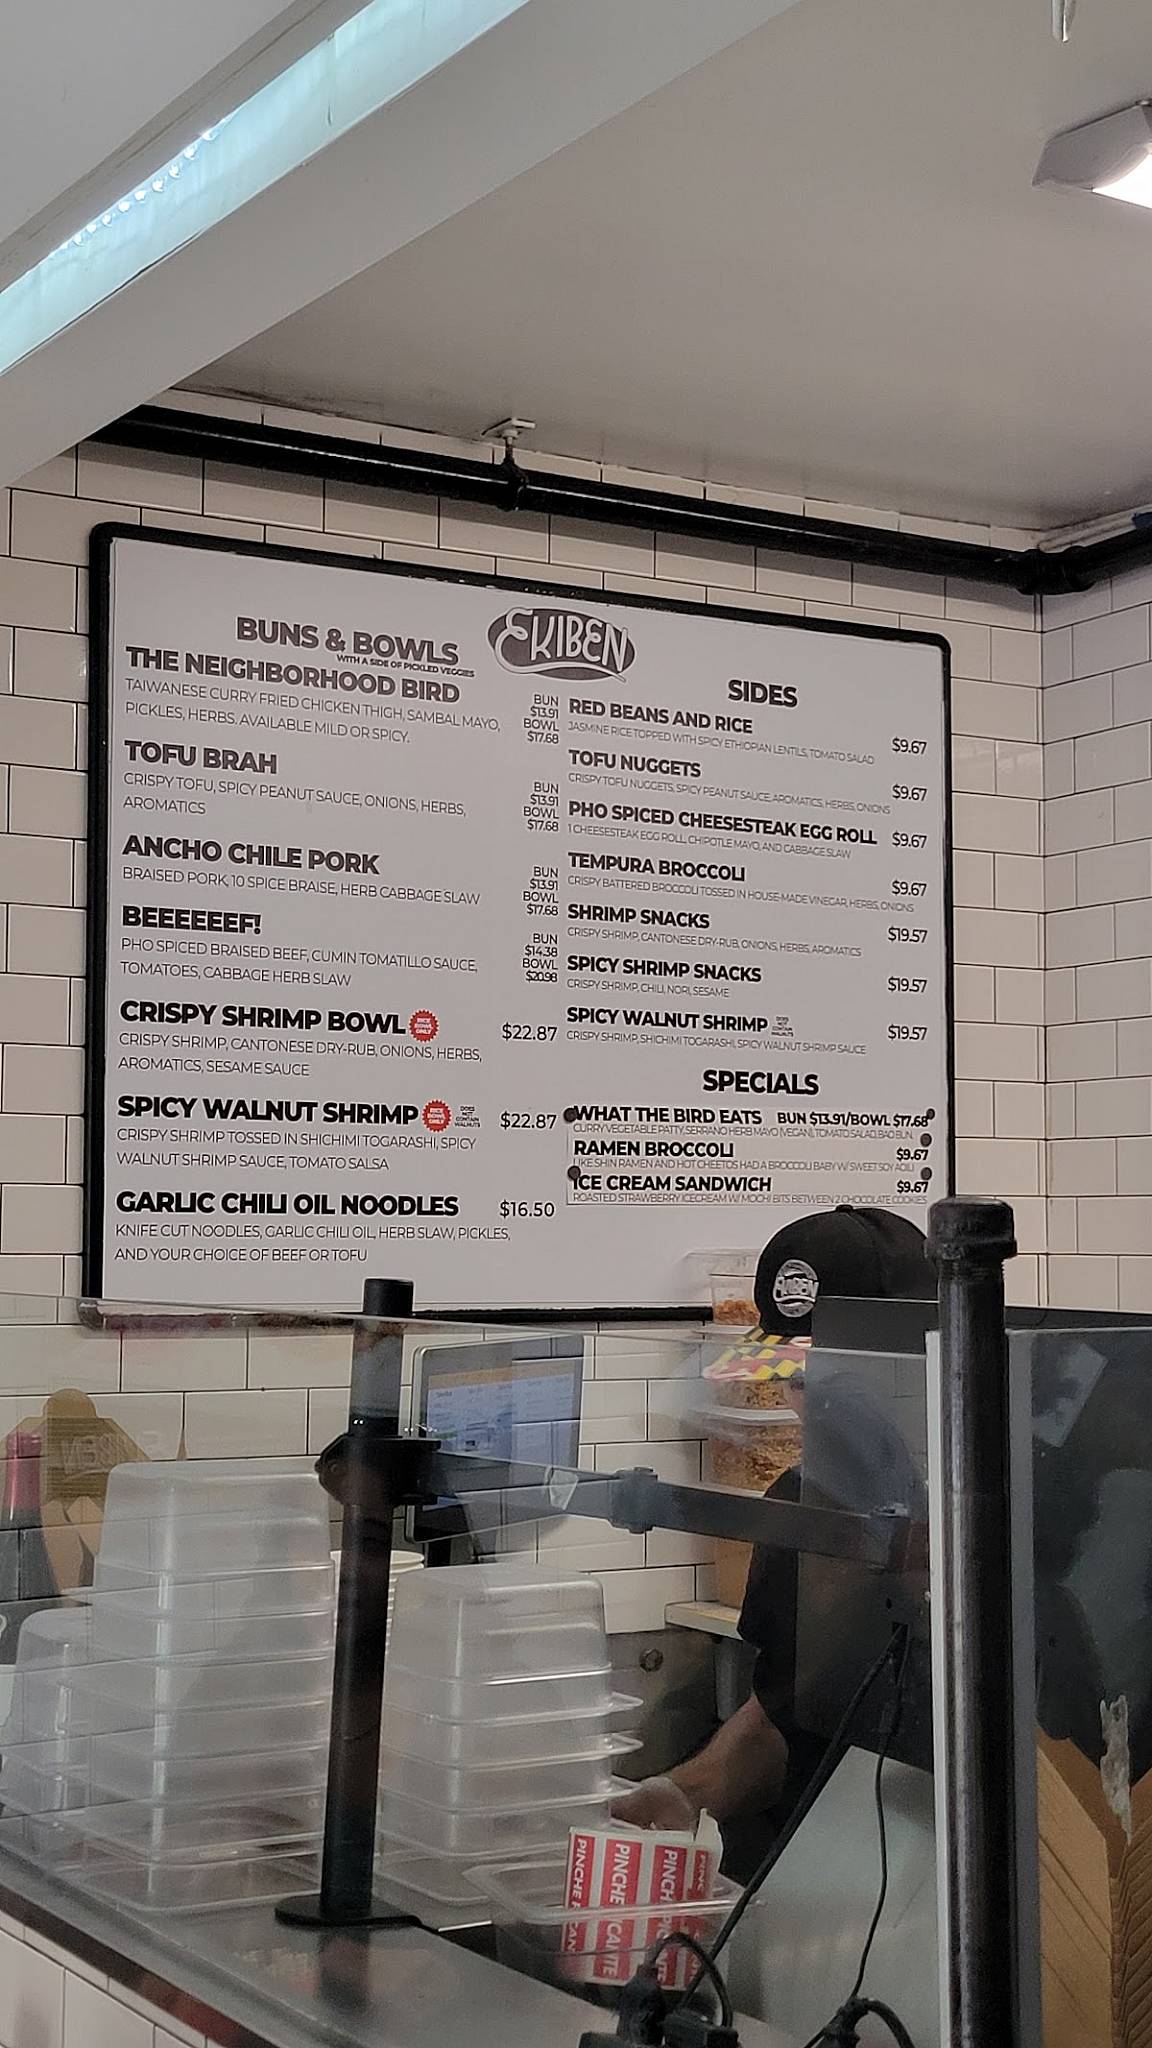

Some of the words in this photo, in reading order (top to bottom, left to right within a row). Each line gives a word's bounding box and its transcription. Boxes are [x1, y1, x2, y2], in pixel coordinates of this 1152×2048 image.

[236, 616, 319, 649] BUNS
[324, 627, 346, 652] &
[353, 630, 458, 665] BOWLS
[494, 606, 628, 682] EKIBEN
[125, 646, 178, 675] THE
[185, 652, 395, 696] NEIGHBORHOOD
[401, 676, 459, 703] BIRD
[336, 654, 360, 665] WITH
[361, 657, 368, 666] A
[369, 658, 388, 668] SIDE
[390, 660, 402, 669] OF
[403, 662, 438, 673] PICKLED
[439, 666, 474, 677] VEGGIES
[533, 694, 558, 707] BUN
[728, 679, 797, 707] SIDES
[125, 678, 207, 699] TAIWANESE
[209, 687, 256, 705] CURRY
[259, 692, 299, 709] FRIED
[300, 697, 360, 716] CHICKEN
[362, 703, 405, 721] THIGH,
[407, 708, 460, 727] SAMBAL
[462, 714, 500, 731] MAYO,
[530, 705, 558, 719] $13.91
[125, 703, 185, 721] PICKLES,
[188, 709, 237, 726] HERBS.
[238, 714, 311, 733] AVAILABLE
[314, 721, 348, 736] MILD
[349, 725, 369, 738] OR
[372, 727, 410, 742] SPICY.
[523, 718, 559, 732] BOWL
[569, 698, 605, 719] RED
[610, 702, 669, 726] BEANS
[672, 709, 711, 730] AND
[714, 713, 752, 734] RICE
[527, 730, 559, 744] $17.68
[892, 737, 927, 755] $9.67
[124, 740, 196, 767] TOFU
[203, 747, 276, 773] BRAH
[568, 749, 616, 771] TOFU
[620, 754, 701, 778] NUGGETS
[533, 782, 558, 794] BUN
[892, 784, 927, 802] $9.67
[530, 794, 558, 806] $13.91
[523, 806, 559, 819] BOWL
[527, 819, 558, 832] $17.68
[568, 800, 608, 820] PHO
[611, 804, 674, 826] SPICED
[678, 811, 796, 837] CHEESESTEAK
[800, 822, 832, 841] EGG
[836, 825, 877, 845] ROLL
[892, 832, 927, 849] $9.67
[122, 835, 222, 863] ANCHO
[227, 843, 302, 869] CHILE
[308, 849, 379, 874] PORK
[533, 867, 558, 878] BUN
[567, 851, 655, 875] TEMPURA
[658, 859, 745, 882] BROCCOLI
[123, 867, 184, 883] BRAISED
[187, 871, 229, 887] PORK,
[231, 875, 244, 888] 10
[247, 876, 285, 891] SPICE
[288, 879, 338, 895] BRAISE,
[340, 883, 377, 898] HERB
[379, 885, 441, 902] CABBAGE
[443, 890, 480, 905] SLAW
[529, 879, 558, 891] $13.91
[891, 880, 927, 897] $9.67
[522, 891, 559, 904] BOWL
[122, 905, 261, 934] BEEEEEEF!
[526, 904, 558, 917] $17.68
[567, 903, 636, 924] SHRIMP
[640, 909, 710, 929] SNACKS
[532, 933, 557, 945] BUN
[887, 927, 927, 944] $19.57
[121, 938, 153, 953] PHO
[156, 940, 207, 956] SPICED
[210, 943, 270, 960] BRAISED
[272, 947, 309, 962] BEEF,
[311, 949, 356, 965] CUMIN
[358, 952, 431, 970] TOMATILLO
[433, 956, 477, 972] SAUCE,
[524, 945, 558, 958] $14.38
[522, 957, 558, 970] BOWL
[567, 955, 619, 974] SPICY
[622, 959, 690, 978] SHRIMP
[693, 963, 761, 983] SNACKS
[525, 971, 557, 984] $20.98
[887, 978, 927, 994] $19.57
[120, 1000, 217, 1027] CRISPY
[221, 1005, 321, 1032] SHRIMP
[327, 1010, 406, 1036] BOWL
[566, 1006, 619, 1026] SPICY
[622, 1009, 700, 1030] WALNUT
[702, 1014, 768, 1033] SHRIMP
[502, 1023, 557, 1042] $22.87
[887, 1025, 927, 1041] $19.57
[118, 1033, 169, 1048] CRISPY
[171, 1036, 228, 1050] SHRIMP,
[230, 1038, 313, 1054] CANTONESE
[316, 1042, 378, 1057] DRY-RUB,
[379, 1044, 434, 1059] ONIONS,
[437, 1047, 482, 1061] HERBS,
[702, 1069, 819, 1095] SPECIALS
[117, 1096, 197, 1119] SPICY
[202, 1098, 318, 1122] WALNUT
[322, 1102, 418, 1125] SHRIMP
[574, 1105, 632, 1124] WHAT
[634, 1107, 670, 1124] THE
[673, 1107, 715, 1125] BIRD
[719, 1108, 762, 1125] EATS
[500, 1112, 556, 1130] $22.87
[777, 1112, 806, 1125] BUN
[892, 1114, 930, 1128] $17.68
[116, 1129, 167, 1142] CRISPY
[169, 1130, 225, 1144] SHRIMP
[226, 1131, 281, 1145] TOSSED
[284, 1133, 297, 1146] IN
[300, 1133, 359, 1147] SHICHIMI
[361, 1135, 438, 1149] TOGARASHI,
[440, 1136, 476, 1150] SPICY
[573, 1140, 640, 1157] RAMEN
[644, 1141, 733, 1158] BROCCOLI
[896, 1148, 928, 1161] $9.67
[606, 1175, 671, 1191] CREAM
[674, 1175, 771, 1191] SANDWICH
[896, 1181, 928, 1194] $9.67
[116, 1191, 215, 1214] GARLIC
[221, 1193, 287, 1215] CHILI
[293, 1194, 335, 1215] OIL
[340, 1194, 458, 1216] NOODLES
[499, 1202, 554, 1218] $16.50
[115, 1225, 158, 1238] KNIFE
[160, 1225, 186, 1238] CUT
[191, 1225, 262, 1238] NOODLES,
[264, 1226, 314, 1239] GARLIC
[316, 1227, 349, 1239] CHILI
[378, 1227, 415, 1240] HERB
[417, 1227, 455, 1240] SLAW,
[458, 1228, 510, 1241] PICKLES,
[571, 1838, 587, 1899] PINCHE
[609, 1842, 630, 1905] PINCHE
[660, 1848, 679, 1903] PINCH
